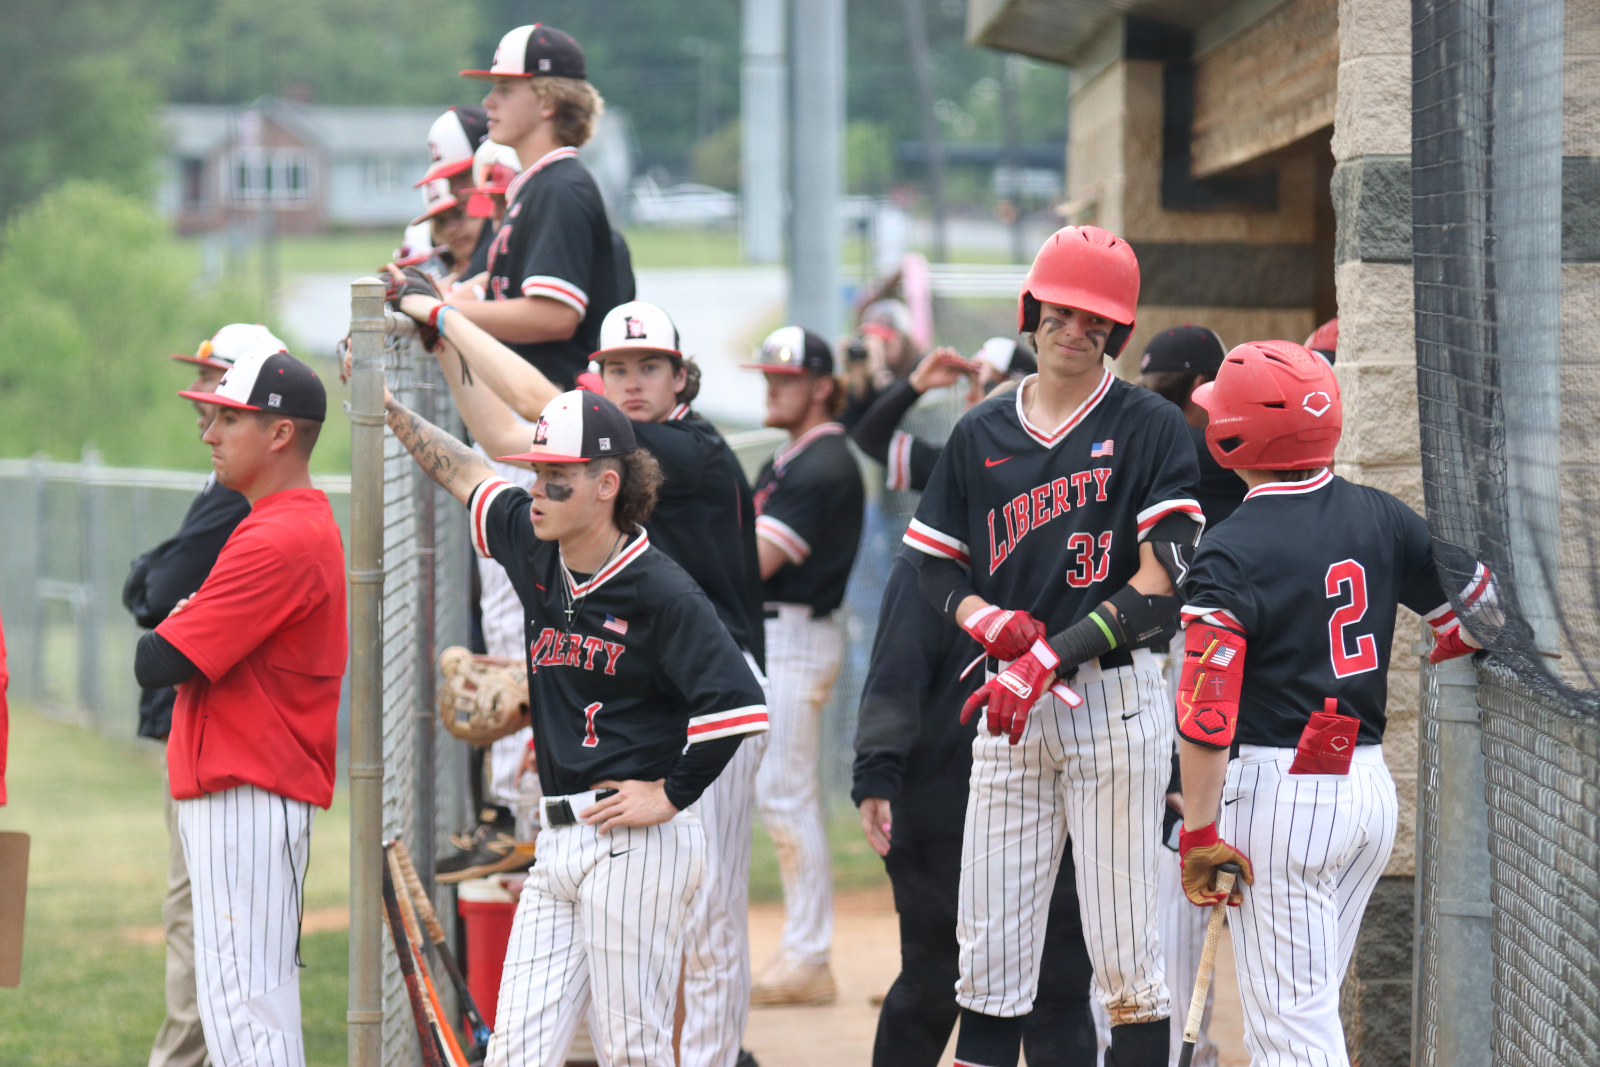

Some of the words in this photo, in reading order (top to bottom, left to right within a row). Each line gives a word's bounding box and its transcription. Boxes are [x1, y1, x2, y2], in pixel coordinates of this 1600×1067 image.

[1214, 416, 1243, 424] EVOSHIELD
[987, 467, 1113, 576] LIBERTY
[1325, 558, 1379, 679] 2
[582, 701, 603, 748] 1
